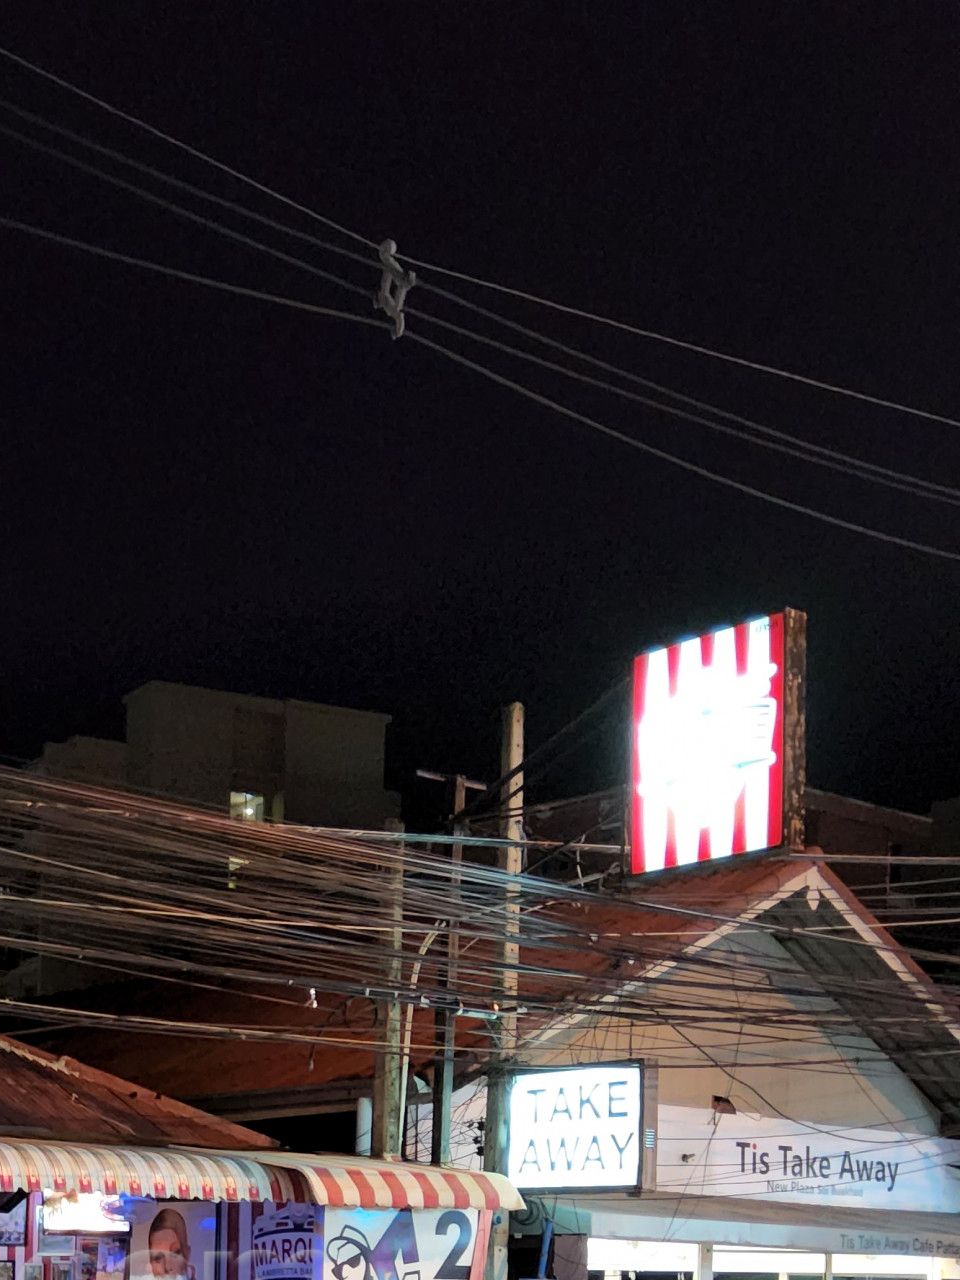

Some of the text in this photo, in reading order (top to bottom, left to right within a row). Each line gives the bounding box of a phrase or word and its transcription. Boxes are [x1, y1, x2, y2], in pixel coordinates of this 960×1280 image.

[526, 1080, 629, 1123] TAKE
[518, 1131, 635, 1174] AWAY
[736, 1141, 899, 1192] Tis Take Away
[766, 1180, 789, 1193] New
[433, 1210, 472, 1280] 2
[840, 1234, 855, 1249] Tis
[858, 1235, 881, 1250] Take
[884, 1237, 910, 1254] Away
[912, 1238, 934, 1253] Cafe
